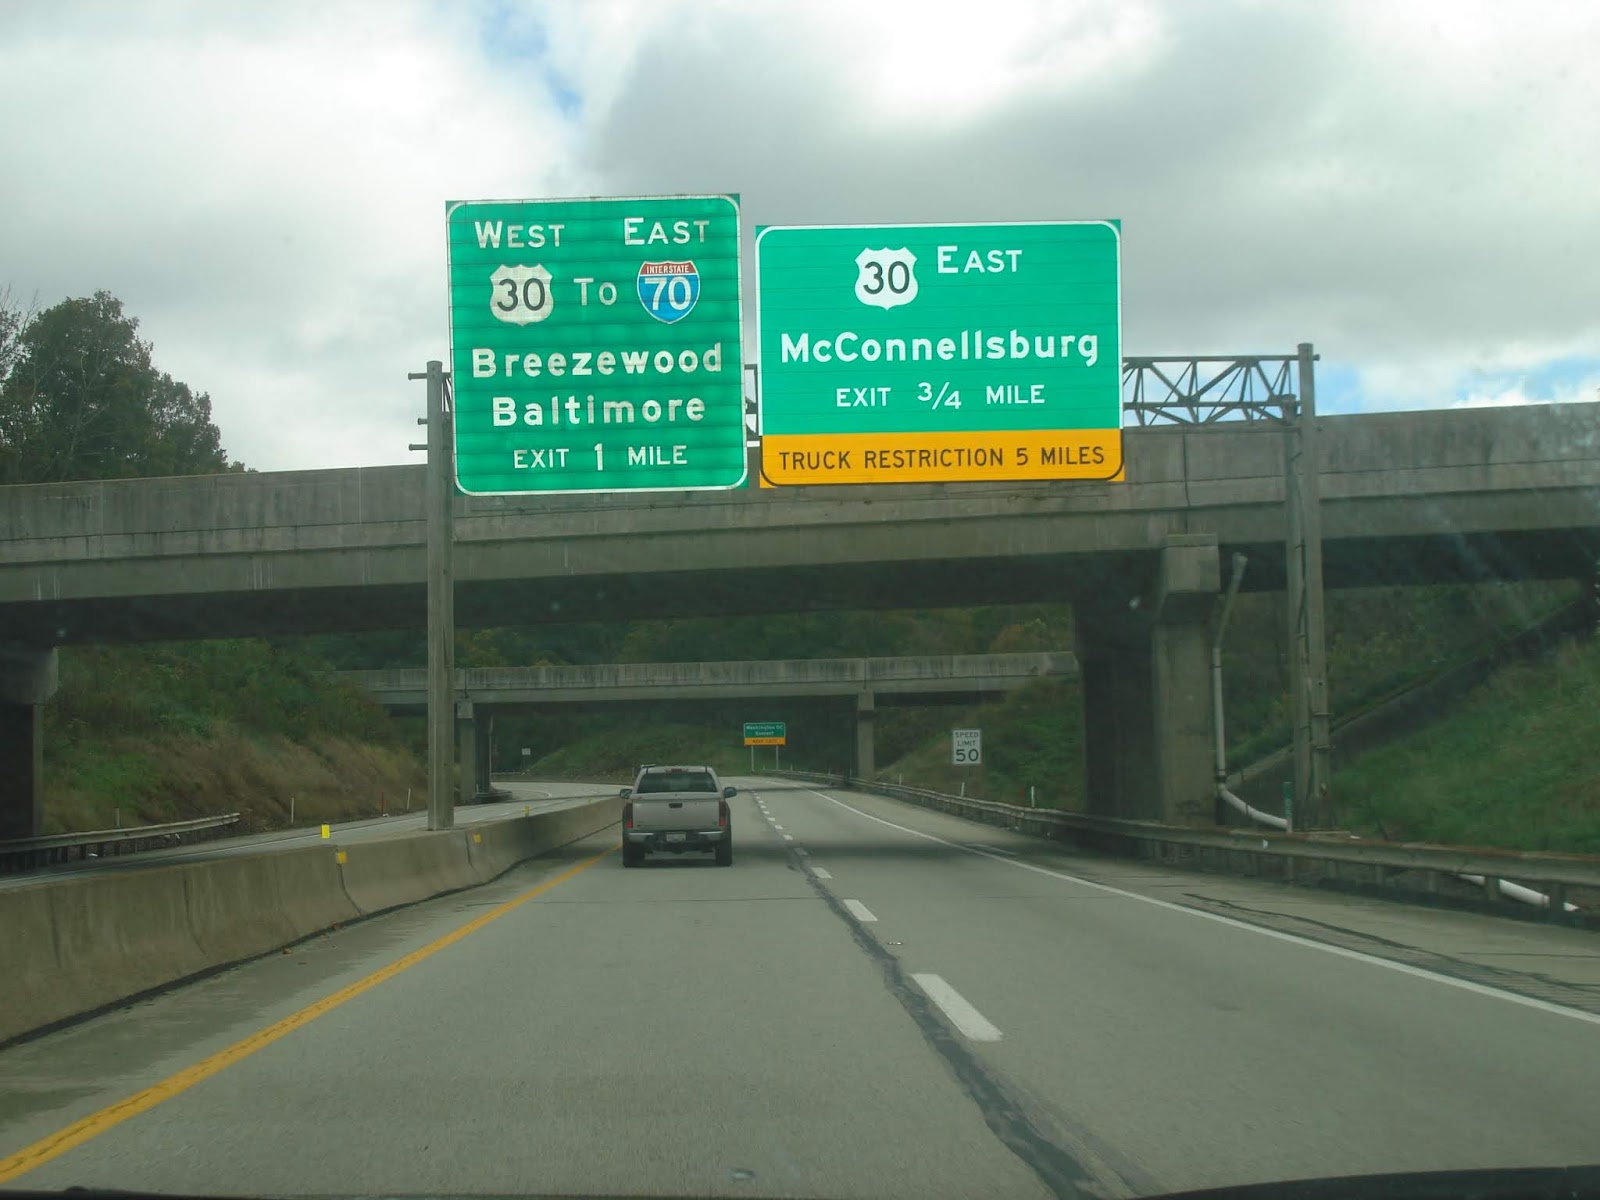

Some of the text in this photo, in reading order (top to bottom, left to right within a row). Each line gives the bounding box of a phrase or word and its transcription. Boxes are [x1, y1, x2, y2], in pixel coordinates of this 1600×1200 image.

[475, 220, 564, 248] WEST
[624, 217, 710, 246] EAST
[646, 264, 690, 274] INTERSTATE
[937, 246, 1023, 274] EAST
[863, 261, 910, 294] 30
[497, 278, 546, 312] 30
[644, 277, 690, 310] 70
[472, 342, 722, 378] Breezewood
[781, 329, 1098, 367] McConnellsburg
[836, 388, 891, 407] EXIT
[986, 385, 1045, 404] MILE
[492, 396, 705, 426] Baltimore
[514, 444, 688, 470] EXIT 1 MILE
[779, 446, 1104, 470] TRUCK RESTRICTION 5 MILES
[955, 748, 979, 762] 50
